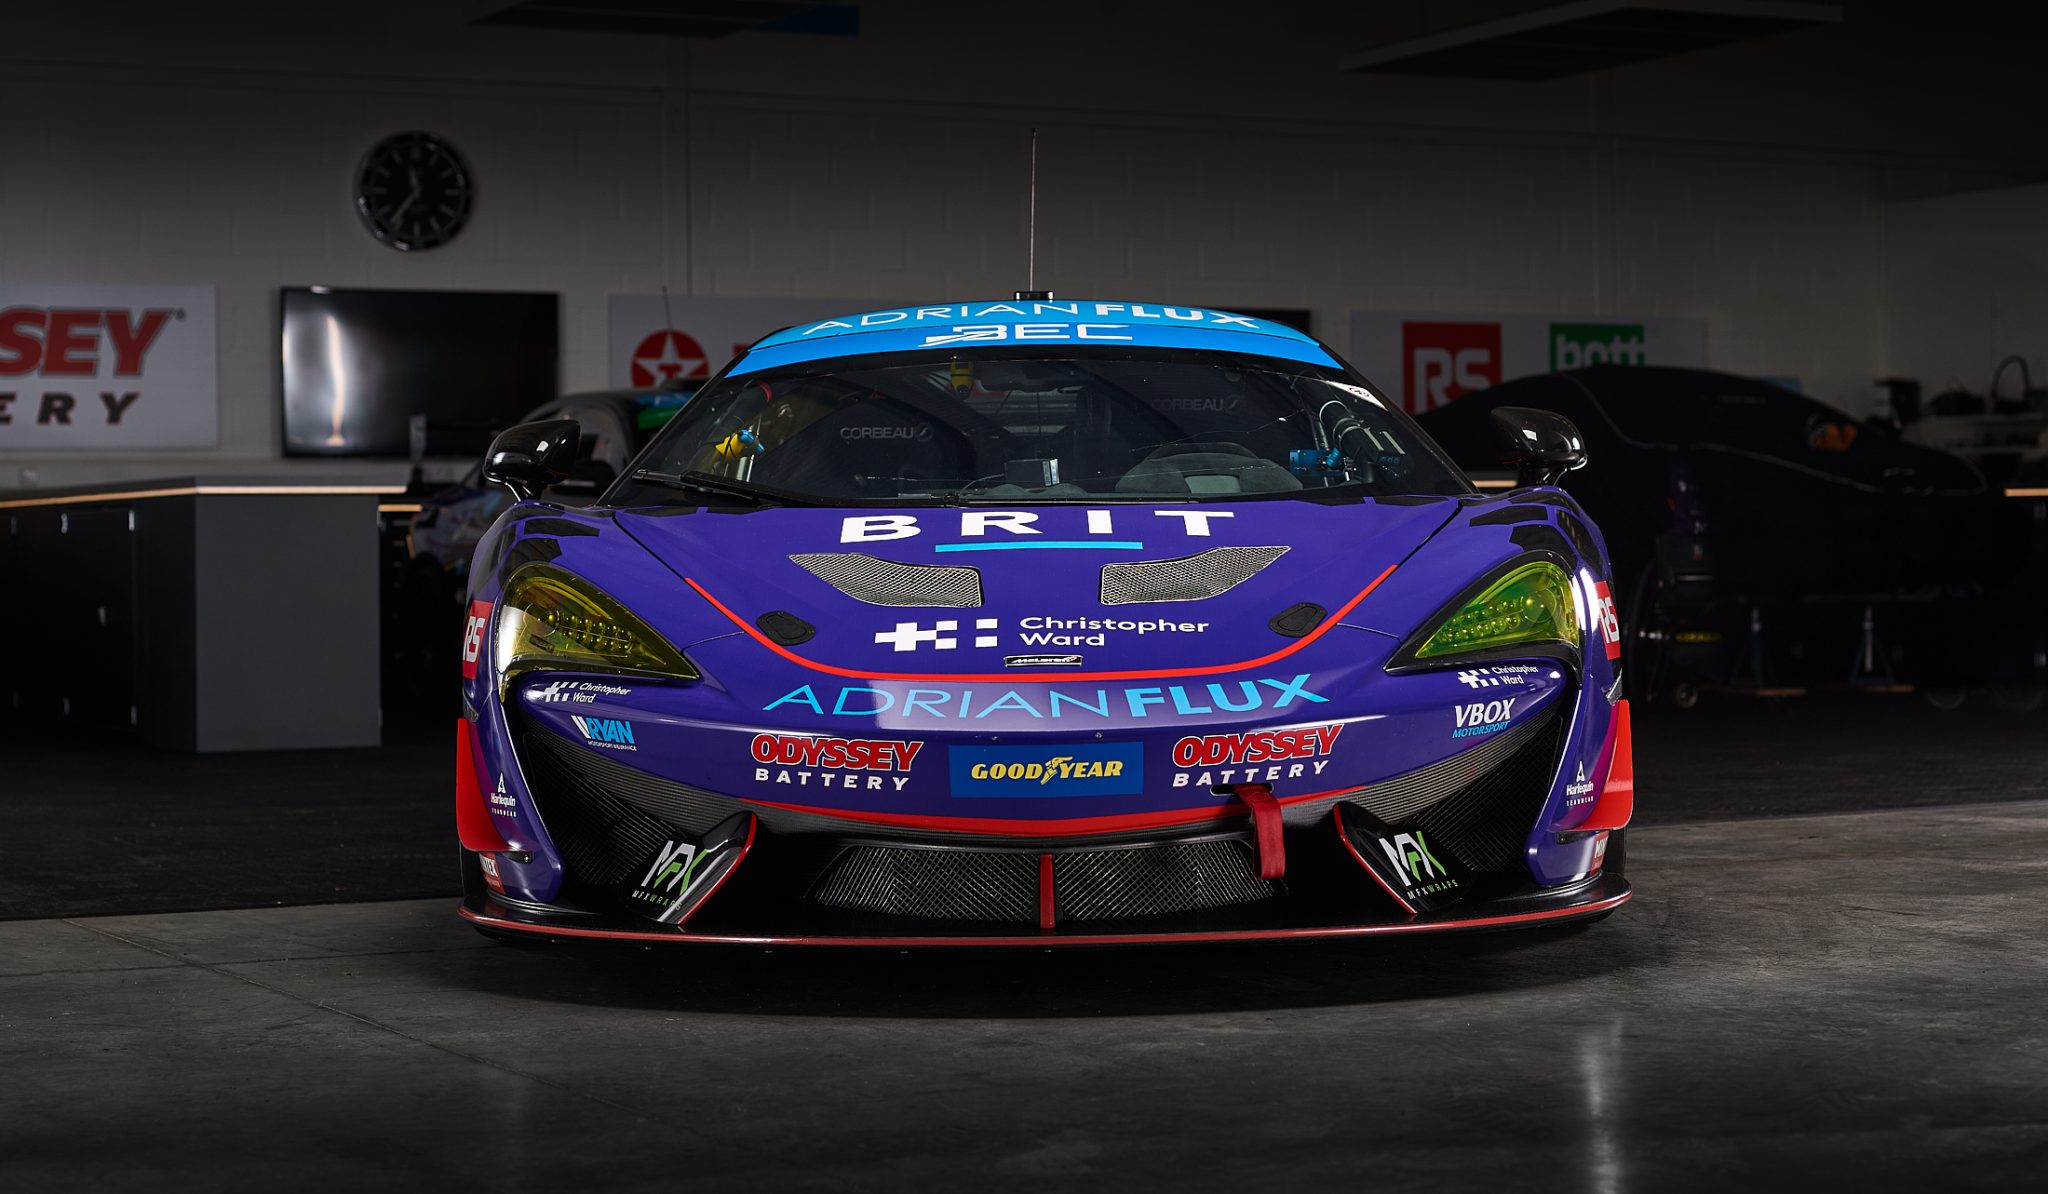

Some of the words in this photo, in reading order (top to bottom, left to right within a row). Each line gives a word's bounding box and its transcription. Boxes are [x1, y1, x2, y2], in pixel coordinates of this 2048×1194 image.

[802, 302, 1077, 336] ADRIAN
[1095, 303, 1260, 329] FLUX
[1411, 346, 1492, 416] RS
[1150, 398, 1224, 411] CORBEAU
[840, 426, 914, 439] CORBEAU
[839, 510, 1235, 545] BRIT
[1019, 616, 1209, 634] Christopher
[1599, 597, 1620, 644] RS
[463, 616, 486, 663] RS
[1019, 632, 1105, 646] Ward
[1491, 665, 1539, 675] Christopher
[1499, 674, 1525, 685] Ward
[572, 692, 596, 703] Ward
[579, 682, 632, 696] Christopher
[762, 684, 1109, 719] ADRIAN
[1124, 673, 1330, 718] FLUX
[1454, 698, 1516, 728] VBOX
[1452, 720, 1511, 739] MOTORSPORT
[750, 734, 925, 773] ODYSSEY
[1172, 724, 1345, 768] ODYSSEY
[755, 768, 910, 792] BATTERY
[1172, 760, 1330, 788] BATTERY
[1566, 781, 1594, 796] Harlequin
[490, 792, 516, 807] Harlequin
